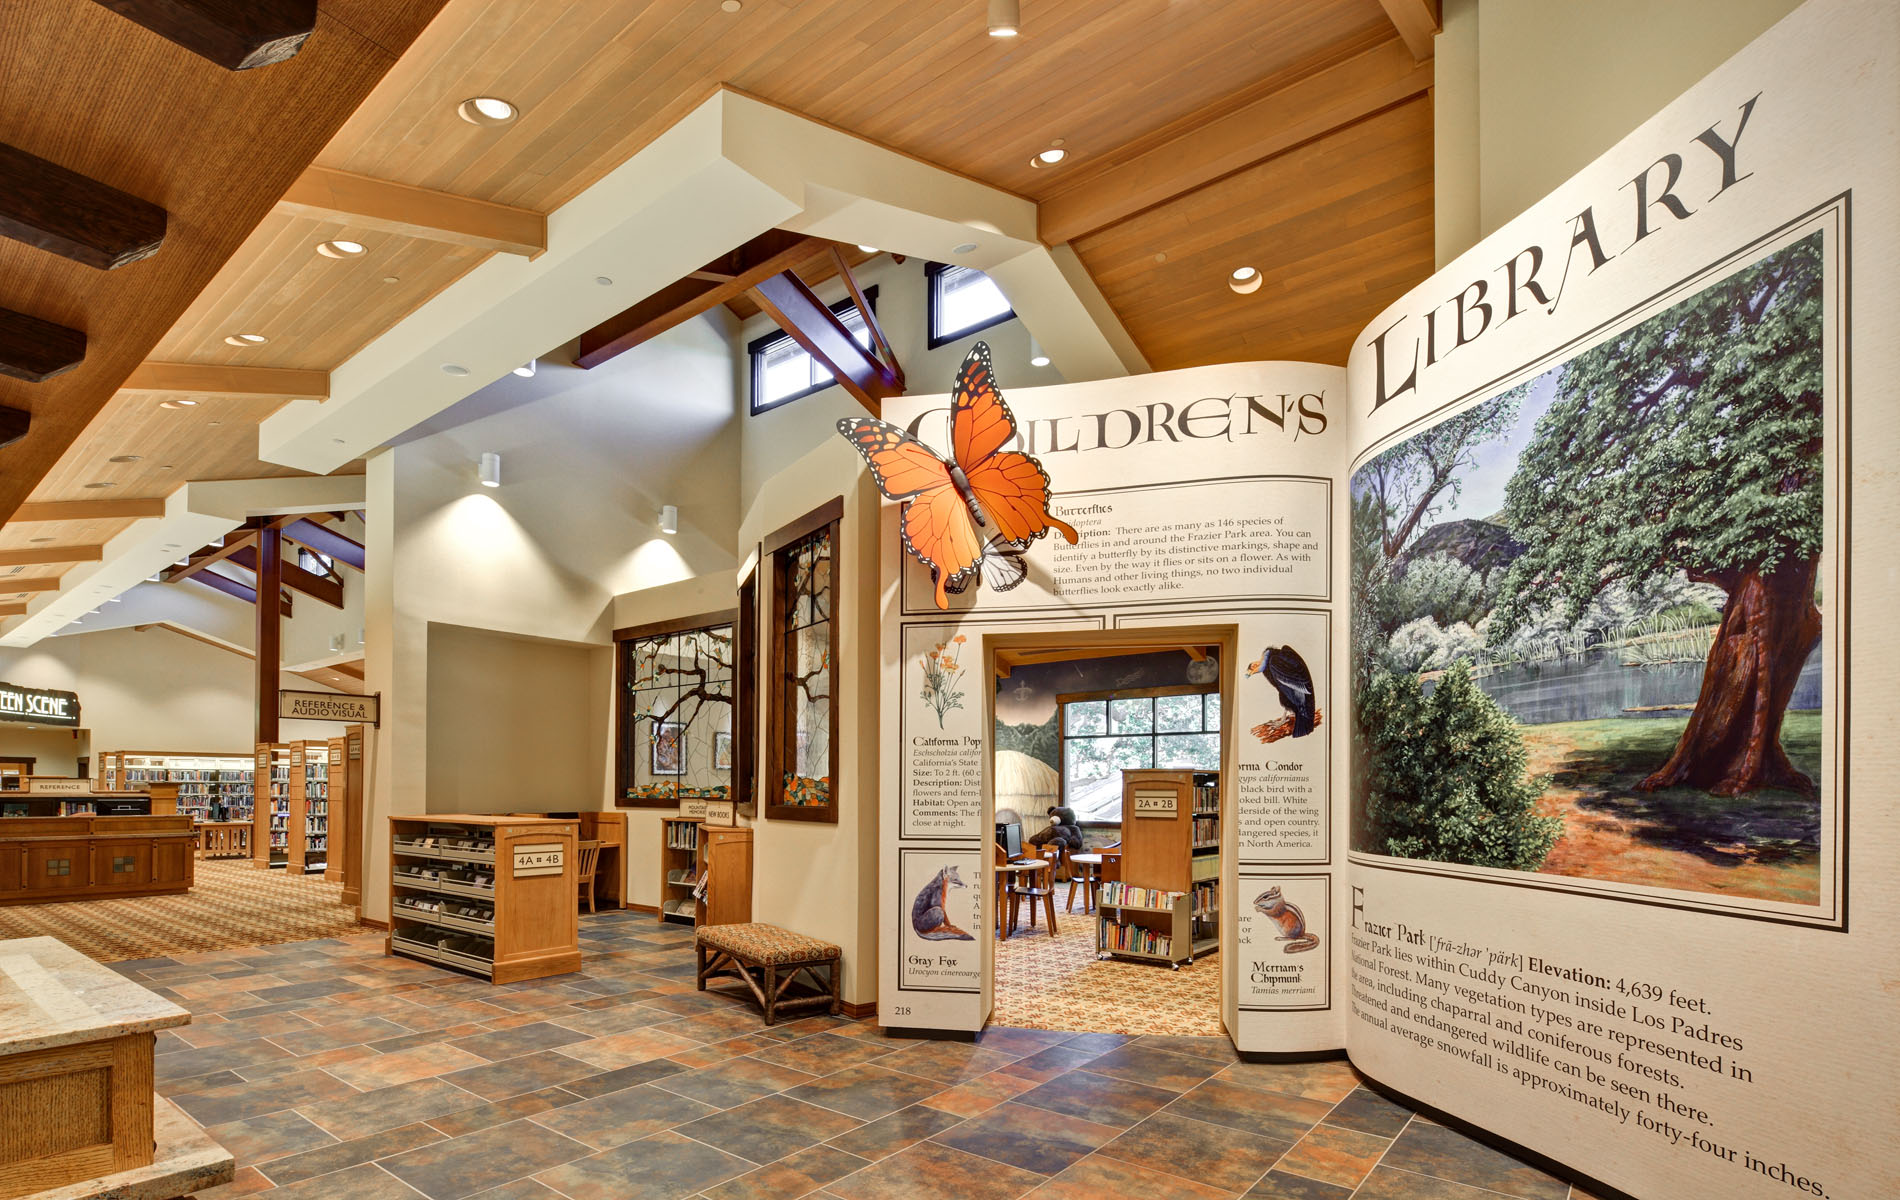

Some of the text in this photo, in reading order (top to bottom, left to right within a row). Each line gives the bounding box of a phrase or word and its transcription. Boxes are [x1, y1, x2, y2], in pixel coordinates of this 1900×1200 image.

[1367, 91, 1763, 418] LIBRARY
[906, 390, 1326, 455] CILDREN'S
[1055, 504, 1113, 516] Butterflies
[1115, 527, 1143, 535] There
[1144, 525, 1160, 533] are
[1174, 522, 1201, 532] many
[1218, 519, 1234, 527] 146
[1236, 517, 1271, 528] species
[1053, 541, 1099, 551] Butterflies
[1113, 538, 1130, 547] and
[1133, 536, 1168, 545] around
[1170, 534, 1185, 542] the
[1188, 533, 1222, 541] Frazier
[1224, 530, 1247, 539] Park
[1249, 530, 1273, 538] area.
[1276, 528, 1294, 537] You
[1053, 540, 1318, 563] identify butterfly its distinctive markings, shape and
[1053, 553, 1311, 574] size. Even the way flies sits flower. with
[1053, 564, 1293, 585] Humans and other living things, two individual
[1053, 581, 1184, 596] butterflies look exactly alike.
[0, 690, 68, 716] EEN SCENE
[294, 699, 355, 711] REFERENCE
[291, 707, 368, 719] AUDIO VISUAL
[912, 736, 959, 747] California
[913, 749, 957, 757] Eschscholzia
[912, 759, 957, 767] California's
[1265, 760, 1303, 771] Condor
[912, 769, 932, 777] Size:
[962, 769, 975, 777] (60
[1259, 774, 1310, 784] californianus
[913, 779, 962, 788] Description:
[1240, 785, 1306, 793] black bird with
[912, 789, 958, 797] flowers and
[913, 799, 969, 808] Habitat: Open
[1138, 799, 1174, 809] 2A 2B
[1263, 796, 1280, 804] bill.
[1282, 796, 1308, 804] White
[912, 809, 975, 817] Comments: The
[1284, 807, 1297, 815] the
[1299, 807, 1319, 817] wing
[912, 819, 966, 828] close night.
[1245, 818, 1320, 828] and open country.
[1279, 830, 1311, 839] species,
[1247, 840, 1313, 848] North America.
[518, 854, 559, 866] 4A 4B
[908, 955, 958, 968] Gray Fox
[1251, 960, 1304, 972] Merriam's
[908, 968, 939, 978] Urocyon
[1395, 922, 1426, 946] Park
[1528, 957, 1611, 990] Elevation:
[1615, 978, 1663, 1002] 4,639
[1669, 990, 1712, 1015] feet.
[1250, 972, 1302, 987] Chipmunk
[1251, 986, 1316, 994] Tamias merriami
[1371, 940, 1392, 957] Park
[1394, 946, 1413, 962] lies
[1416, 954, 1455, 974] within
[1459, 962, 1506, 990] Cuddy
[1510, 975, 1570, 1004] Canyon
[1575, 991, 1627, 1019] inside
[1632, 1005, 1665, 1030] Los
[1671, 1016, 1744, 1051] Padres
[895, 1007, 911, 1016] 218
[1378, 961, 1412, 982] Forest.
[1415, 971, 1450, 995] Many
[1454, 985, 1526, 1015] vegetation
[1530, 1003, 1573, 1027] types
[1577, 1019, 1603, 1037] are
[1608, 1027, 1723, 1075] represented
[1730, 1060, 1753, 1084] in
[1359, 974, 1685, 1089] area, including chaparral and coniferous forests.
[1390, 1006, 1410, 1020] and
[1413, 1013, 1488, 1046] endangered
[1492, 1038, 1550, 1067] wildlife
[1554, 1058, 1582, 1078] can
[1610, 1079, 1651, 1104] seen
[1656, 1093, 1714, 1126] there.
[1360, 1009, 1831, 1200] annual average snowfall approximately forty-four inches.
